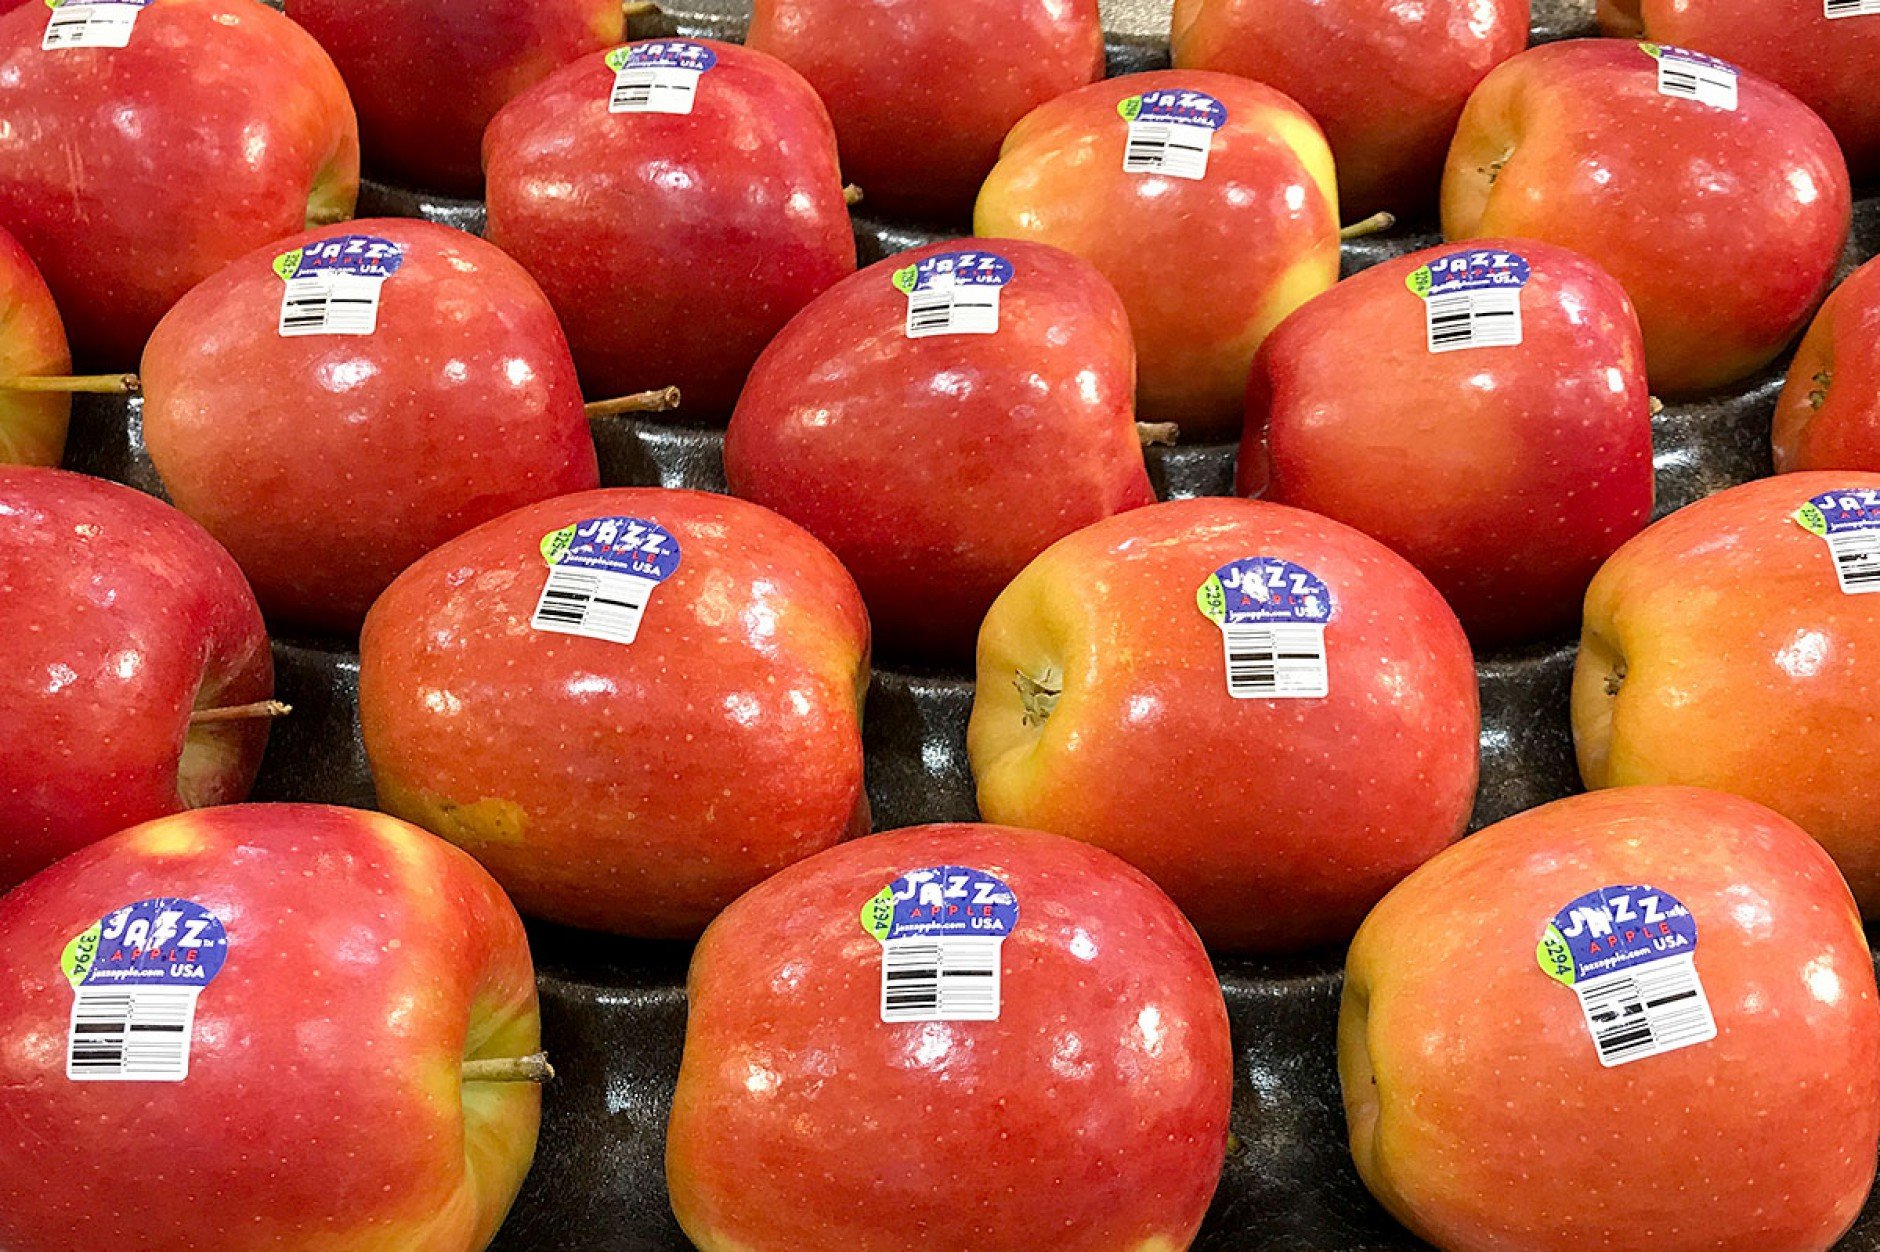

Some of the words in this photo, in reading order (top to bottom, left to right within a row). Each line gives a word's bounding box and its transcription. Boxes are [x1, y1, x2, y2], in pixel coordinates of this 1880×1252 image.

[633, 44, 703, 57] JAZZ
[1144, 92, 1213, 111] JAZZ
[305, 240, 389, 258] JAZZ
[920, 255, 996, 272] JAZZ
[1432, 253, 1510, 271] JAZZ
[578, 519, 666, 554] JAZZ
[632, 562, 661, 577] USA
[894, 872, 995, 905] JAZZ
[910, 905, 993, 917] APPLE
[103, 906, 209, 948] JAZZ
[971, 917, 1004, 930] USA
[1589, 922, 1671, 953] APPLE
[1653, 933, 1689, 951] USA
[73, 935, 97, 975] 3294
[111, 949, 198, 962] APPLE
[170, 963, 206, 979] USA
